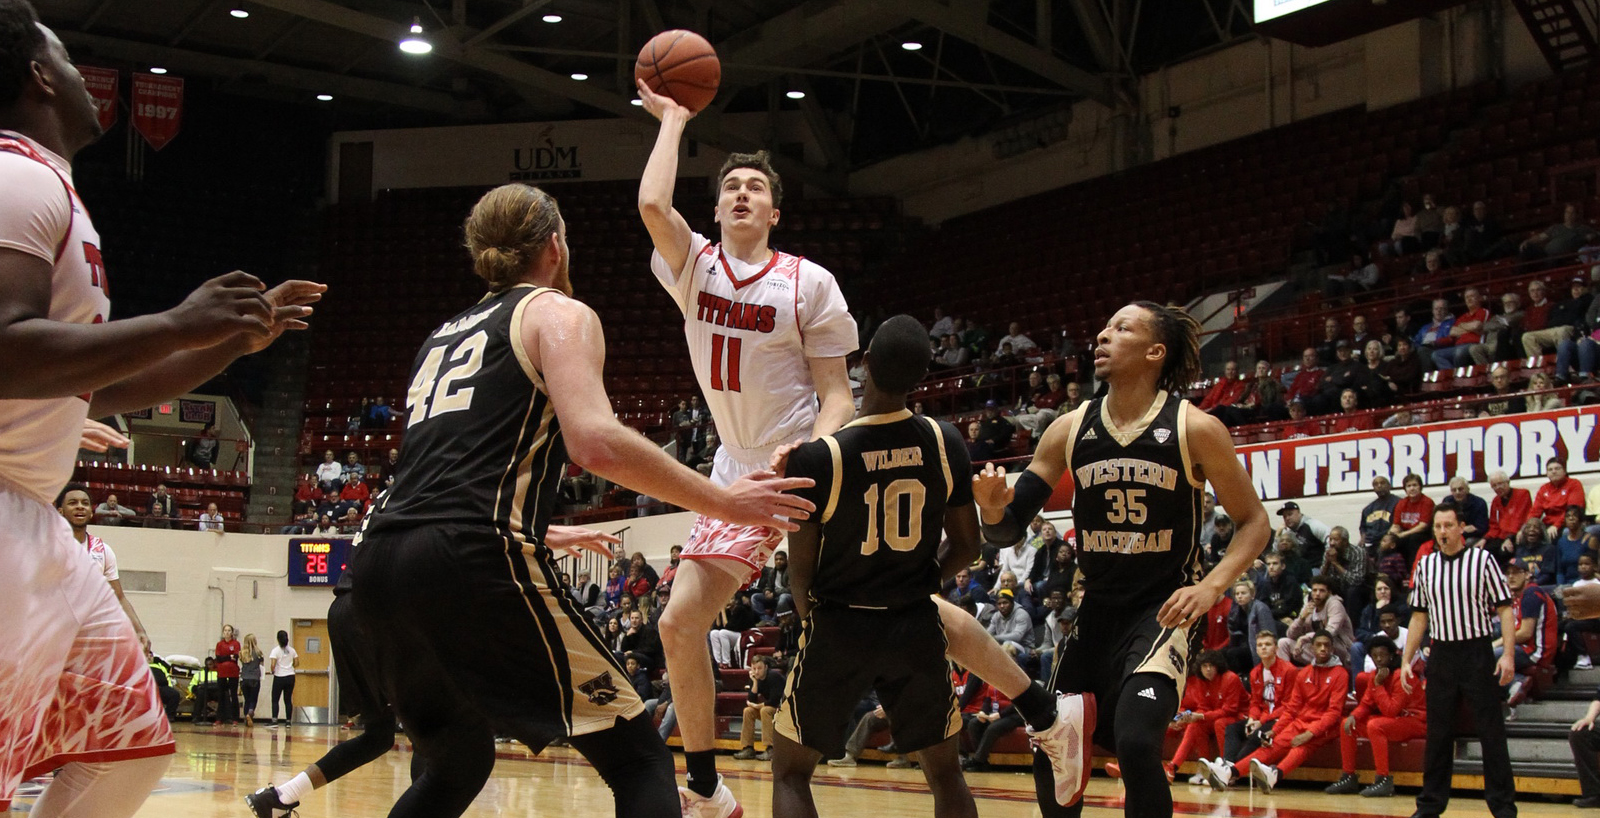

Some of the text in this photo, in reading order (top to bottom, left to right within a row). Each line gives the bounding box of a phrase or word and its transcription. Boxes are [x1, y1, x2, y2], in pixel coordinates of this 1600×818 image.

[82, 74, 115, 84] ERENCE
[135, 81, 181, 93] TOURNAMENT
[138, 88, 177, 98] CHAMPIONS
[137, 103, 178, 120] 1997
[514, 146, 579, 171] UDM
[697, 291, 777, 333] TITANS
[710, 333, 742, 393] 11
[406, 329, 489, 430] 42
[861, 446, 924, 473] WILDER
[1294, 413, 1598, 496] TERRITORY
[1075, 458, 1178, 491] WESTERN
[860, 479, 927, 556] 10
[1104, 489, 1148, 525] 35
[300, 543, 331, 553] TITANS
[1082, 529, 1174, 554] MICHIGAN
[306, 553, 328, 574] 26
[309, 575, 329, 583] BONUS
